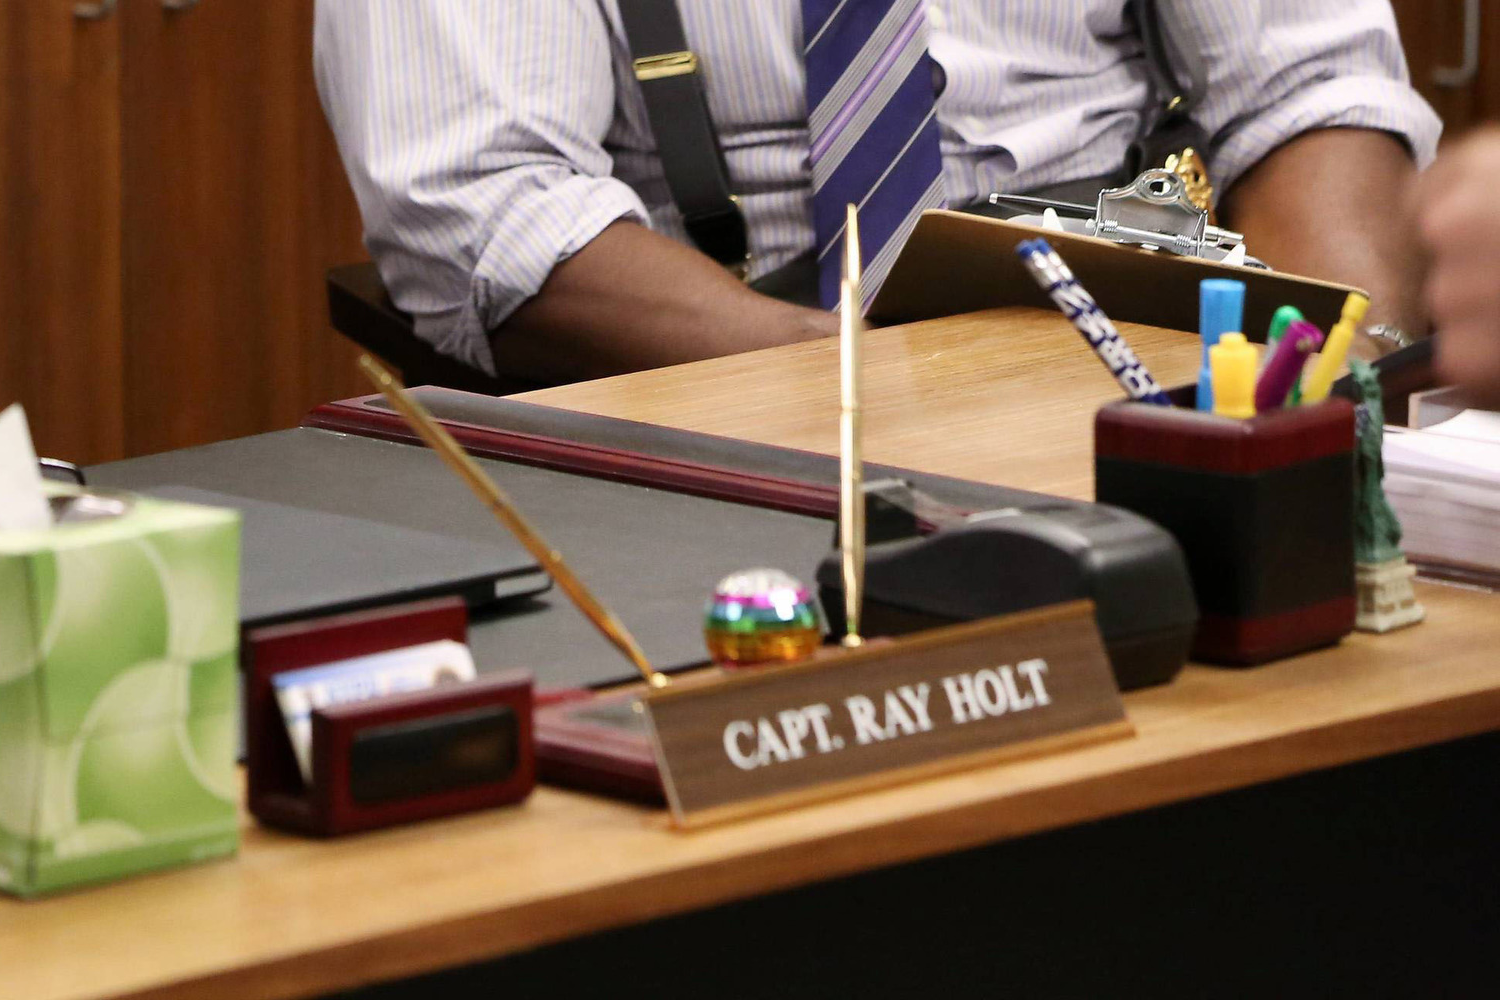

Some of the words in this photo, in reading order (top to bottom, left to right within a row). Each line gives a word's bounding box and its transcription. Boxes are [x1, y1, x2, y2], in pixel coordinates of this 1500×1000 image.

[722, 703, 845, 771] CAPT.
[844, 682, 935, 745] RAY
[941, 658, 1051, 724] HOLT
